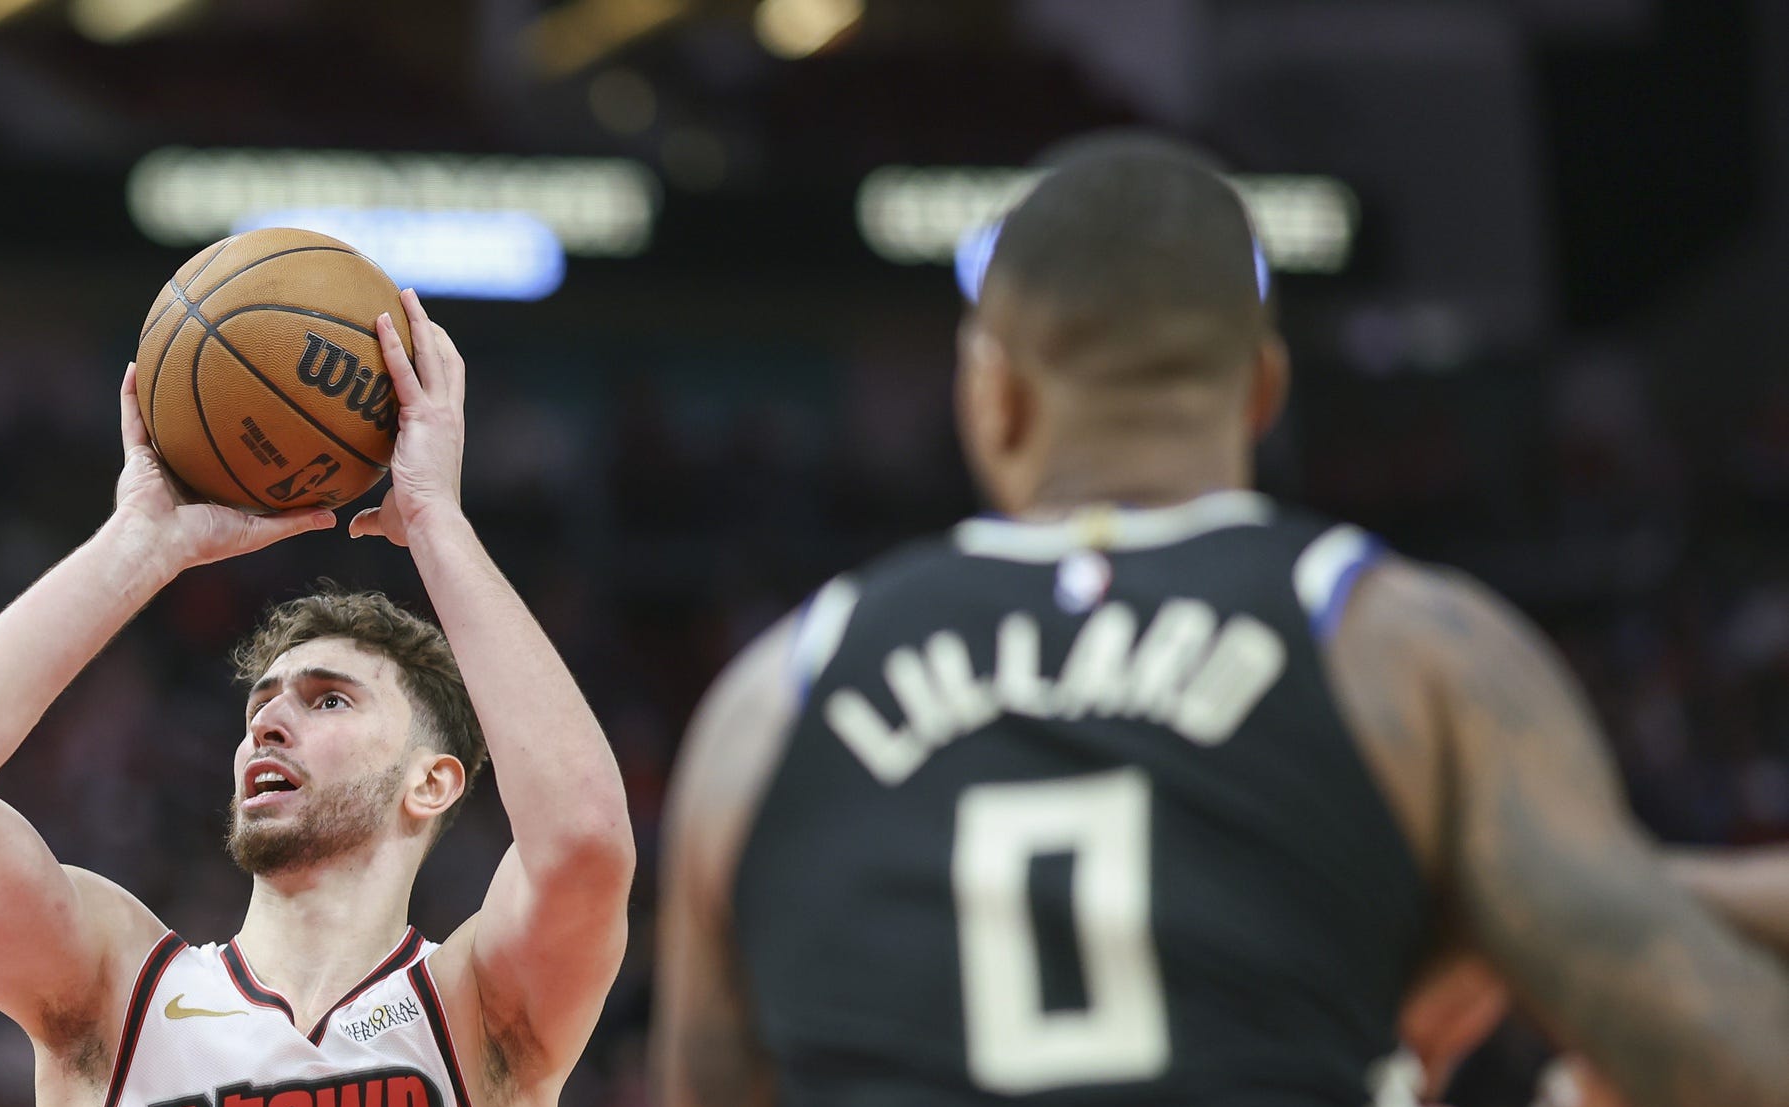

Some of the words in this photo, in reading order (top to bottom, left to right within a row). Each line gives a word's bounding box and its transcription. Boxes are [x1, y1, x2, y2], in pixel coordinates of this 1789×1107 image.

[824, 598, 1288, 787] LILLARD
[951, 766, 1173, 1096] 0
[339, 996, 415, 1036] MEMORIAL
[345, 1003, 420, 1041] ERMANN
